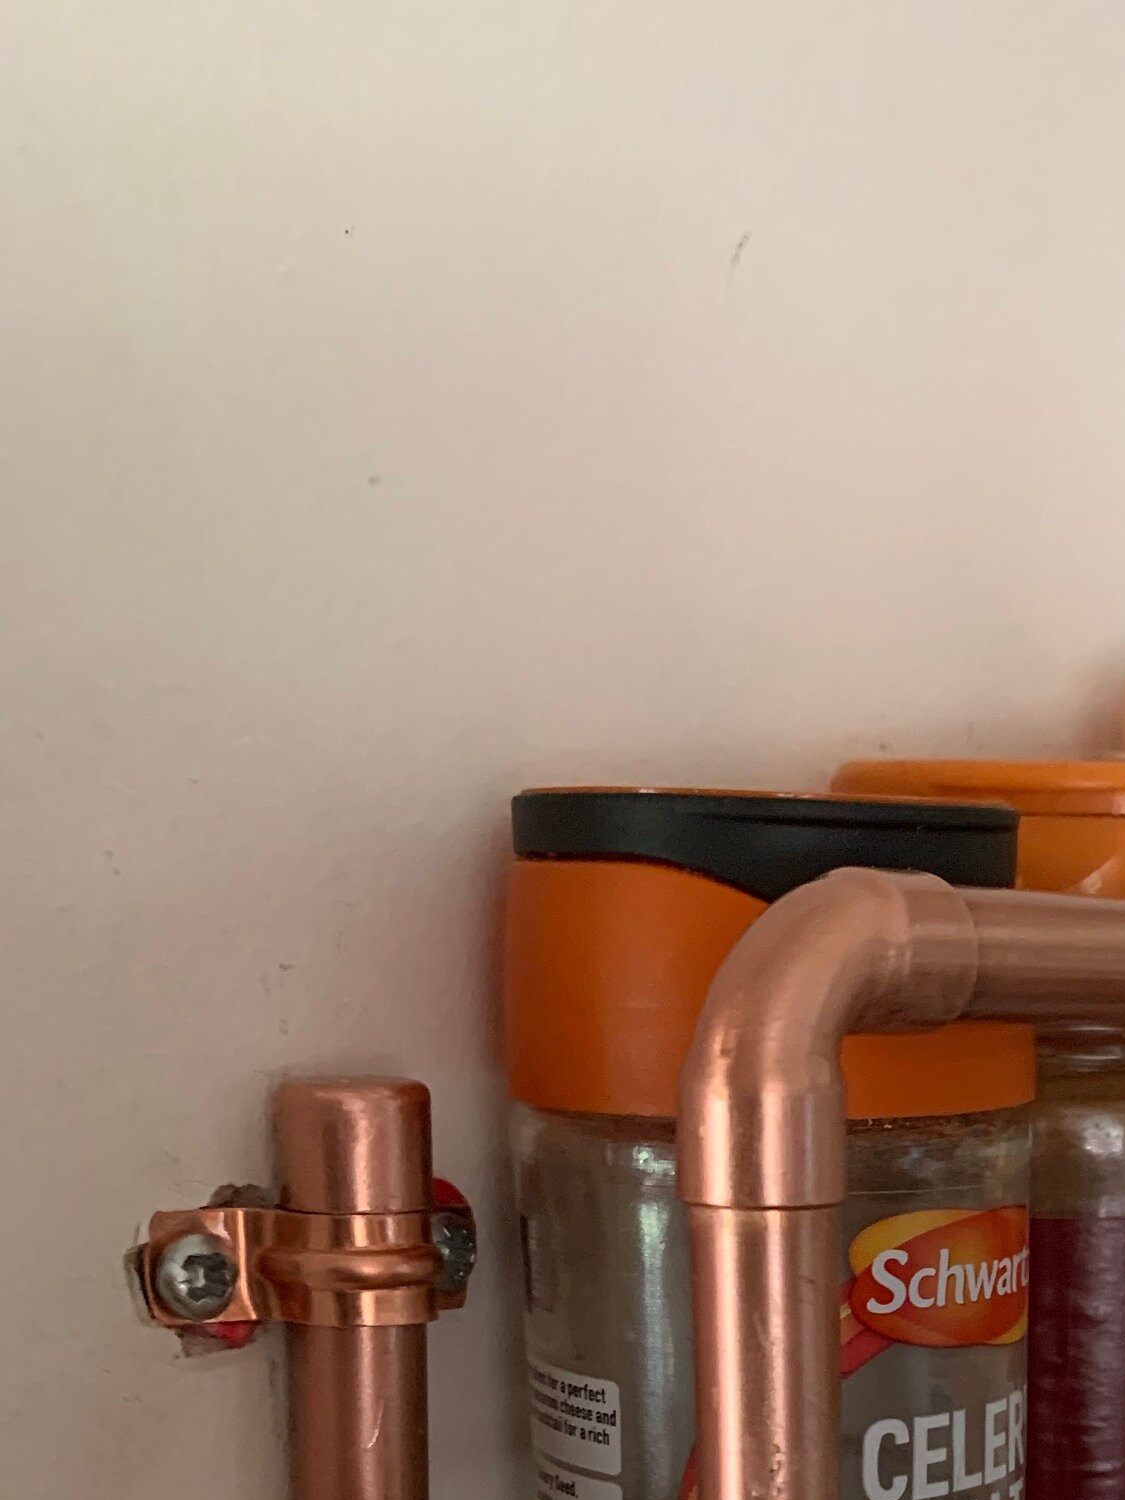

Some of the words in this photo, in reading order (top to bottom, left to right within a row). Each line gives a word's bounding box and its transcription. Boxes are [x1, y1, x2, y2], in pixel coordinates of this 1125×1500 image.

[568, 1383, 607, 1404] perfect
[560, 1398, 593, 1421] cheese
[596, 1410, 617, 1427] and
[589, 1426, 610, 1446] rich
